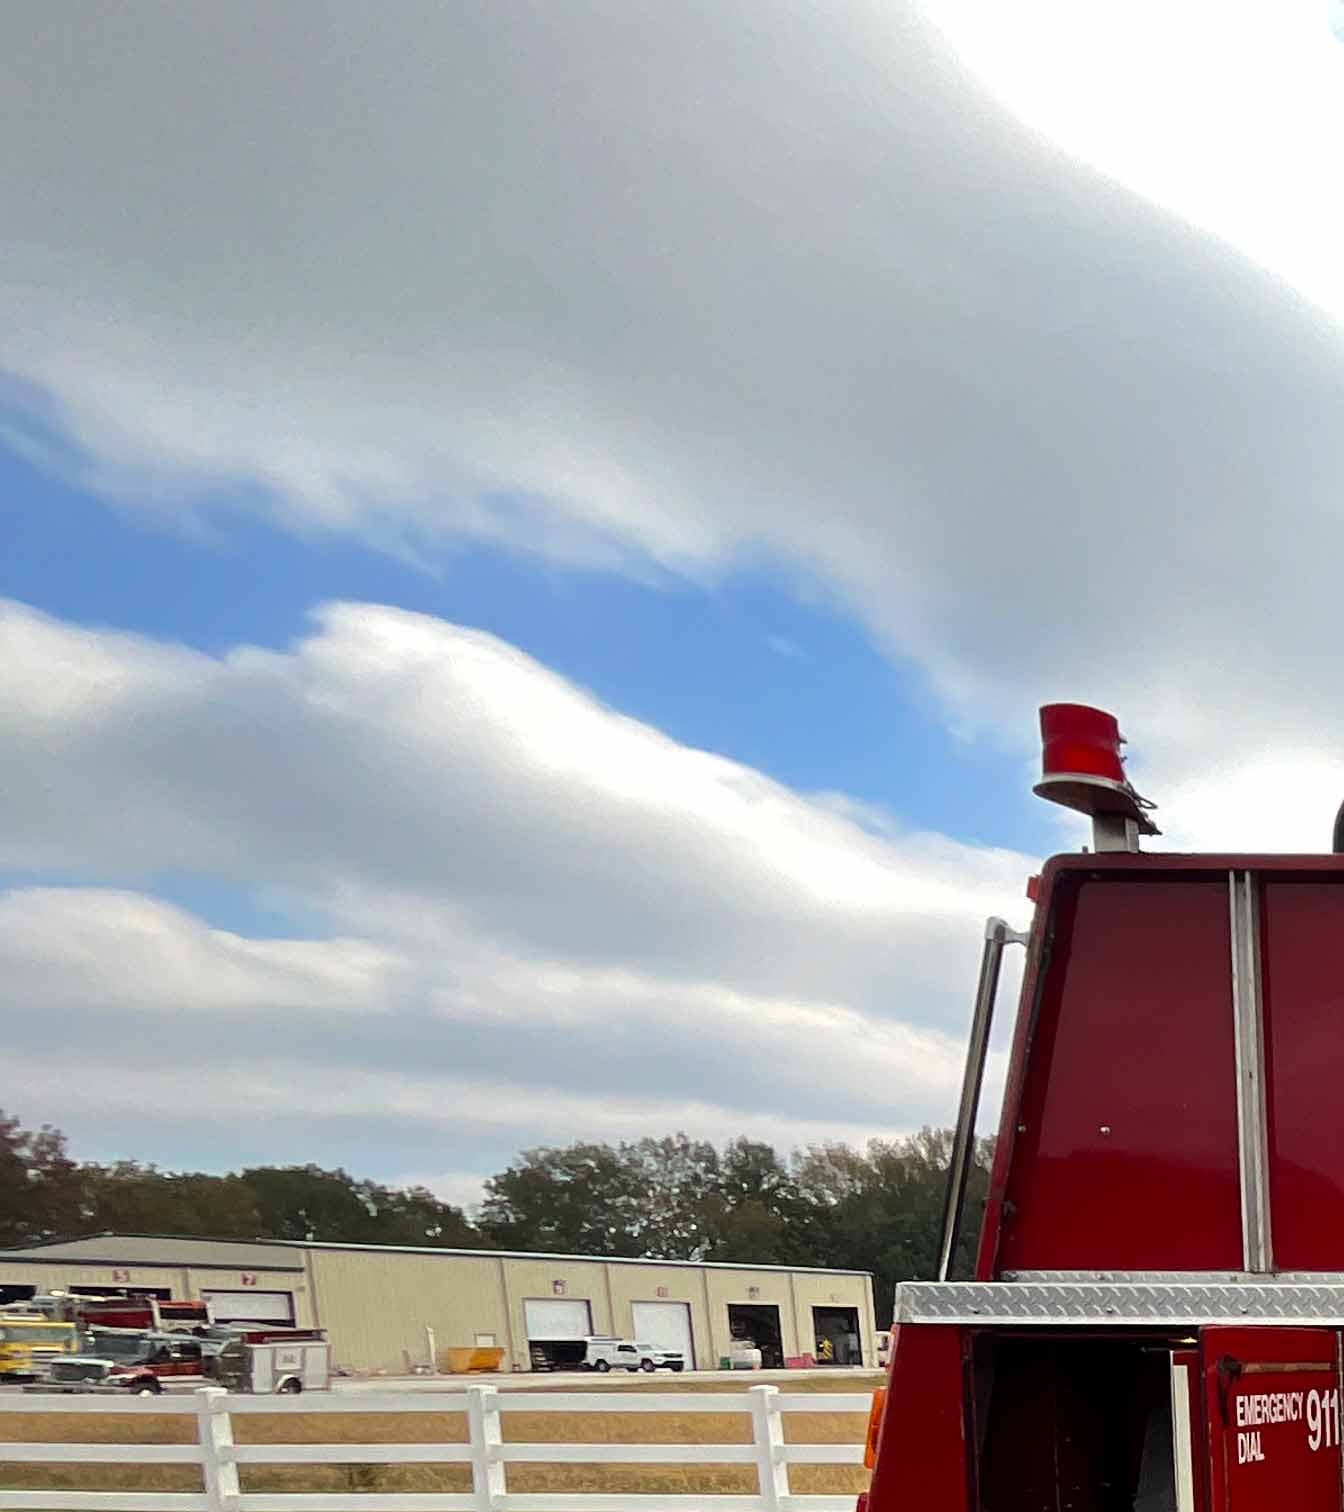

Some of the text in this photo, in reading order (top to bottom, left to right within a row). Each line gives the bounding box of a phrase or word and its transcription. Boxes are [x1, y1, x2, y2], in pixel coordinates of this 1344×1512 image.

[1236, 1392, 1304, 1427] EMERGENCY
[1306, 1389, 1340, 1451] 911
[1237, 1431, 1265, 1464] DIAL
